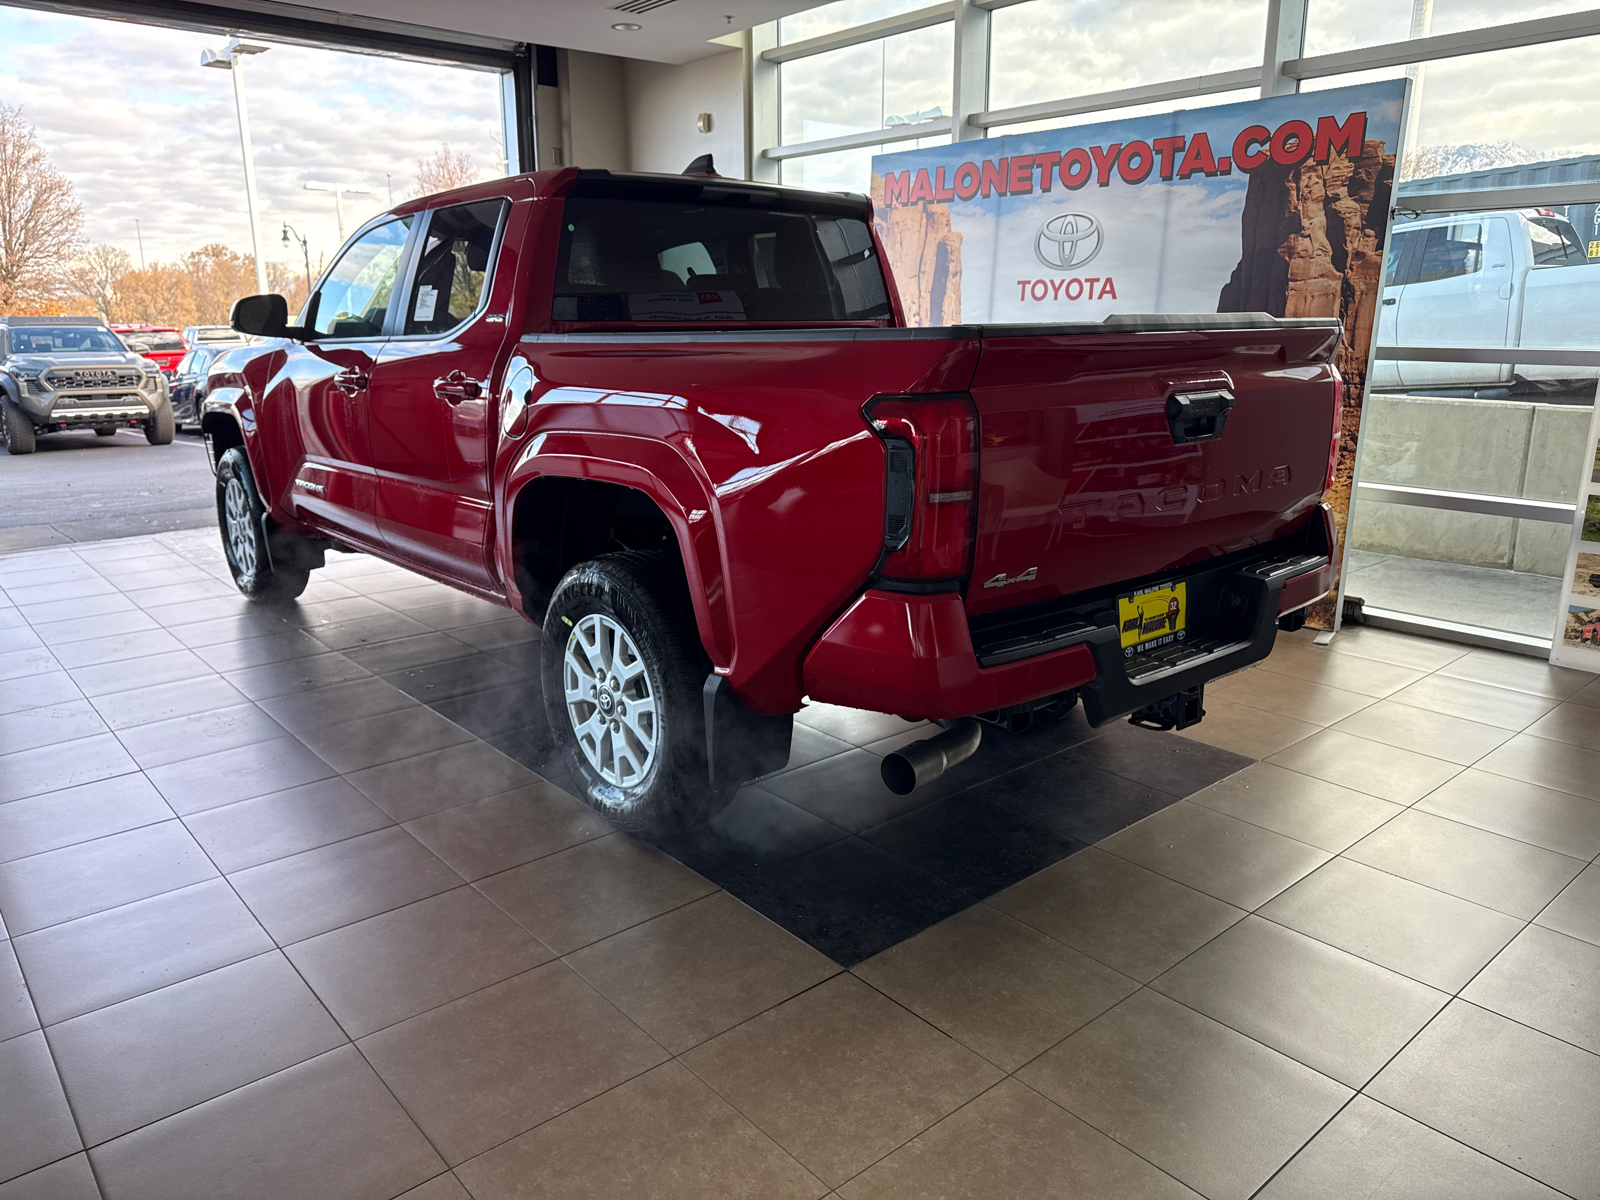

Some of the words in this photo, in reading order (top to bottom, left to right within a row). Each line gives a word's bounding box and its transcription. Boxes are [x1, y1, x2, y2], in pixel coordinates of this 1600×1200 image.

[884, 110, 1369, 208] MALONETOYOTA.COM
[1017, 276, 1118, 302] TOYOTA
[1058, 463, 1293, 529] TACOMA
[1170, 601, 1177, 611] 32
